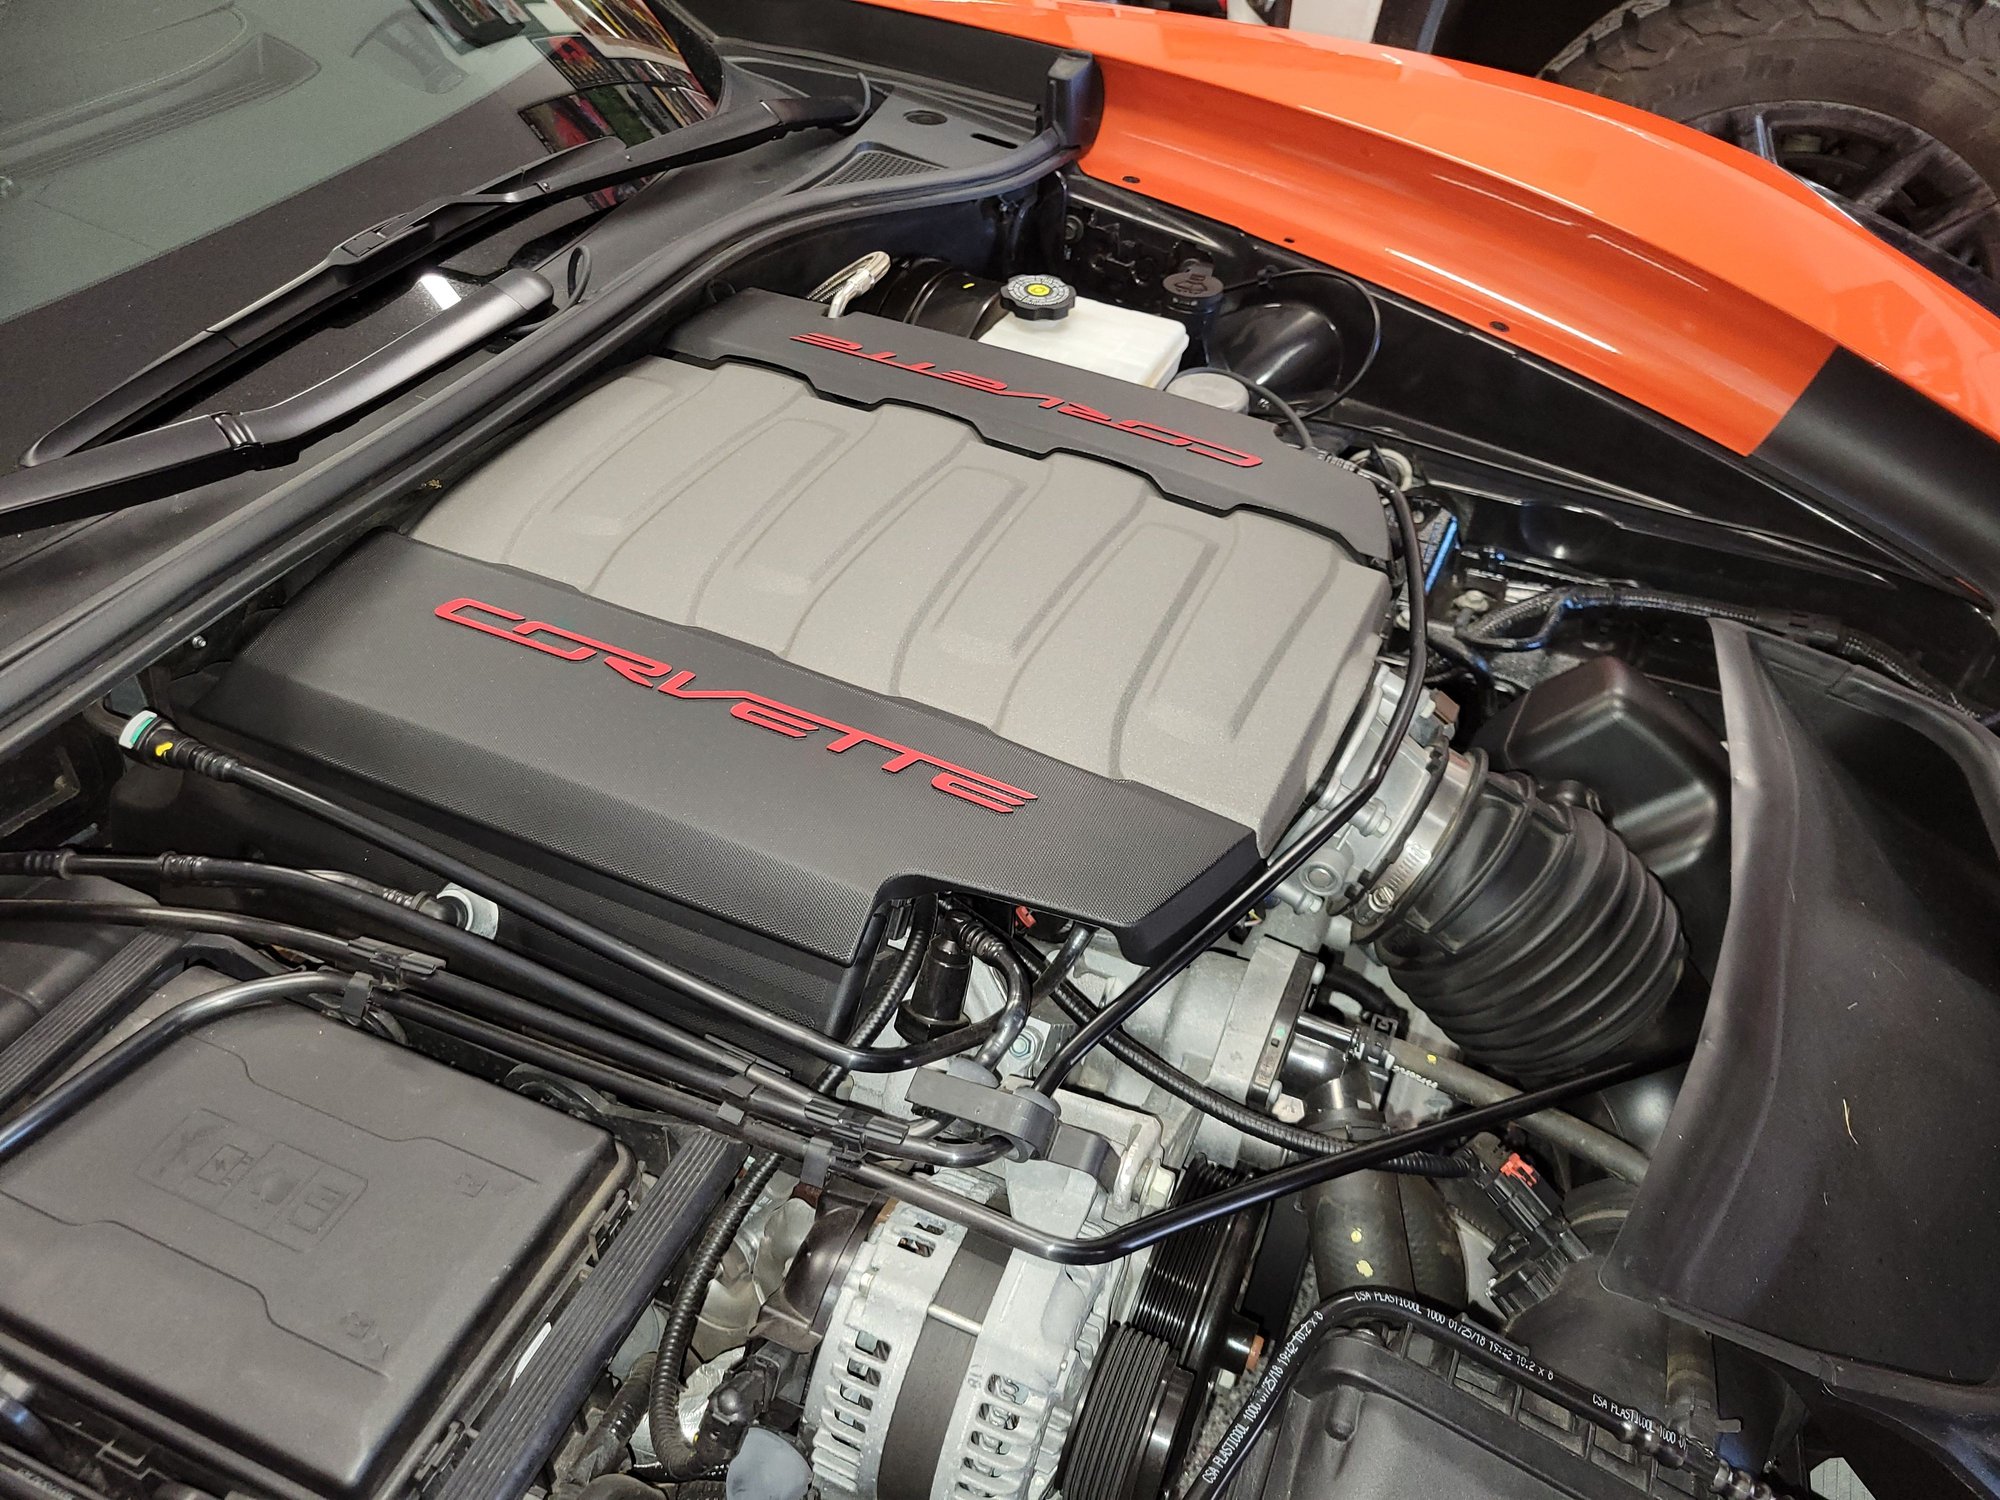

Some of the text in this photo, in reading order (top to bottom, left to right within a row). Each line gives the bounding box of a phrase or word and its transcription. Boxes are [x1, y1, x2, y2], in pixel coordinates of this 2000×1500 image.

[789, 333, 1263, 468] CORVETTE
[434, 598, 1039, 814] CORVETTE
[1276, 1339, 1299, 1367] 19:42
[1313, 1310, 1324, 1321] 8
[1426, 1308, 1446, 1324] 1000
[1448, 1318, 1486, 1346] 01/25/18
[1516, 1354, 1536, 1372] 10.2
[1659, 1425, 1676, 1445] 1000
